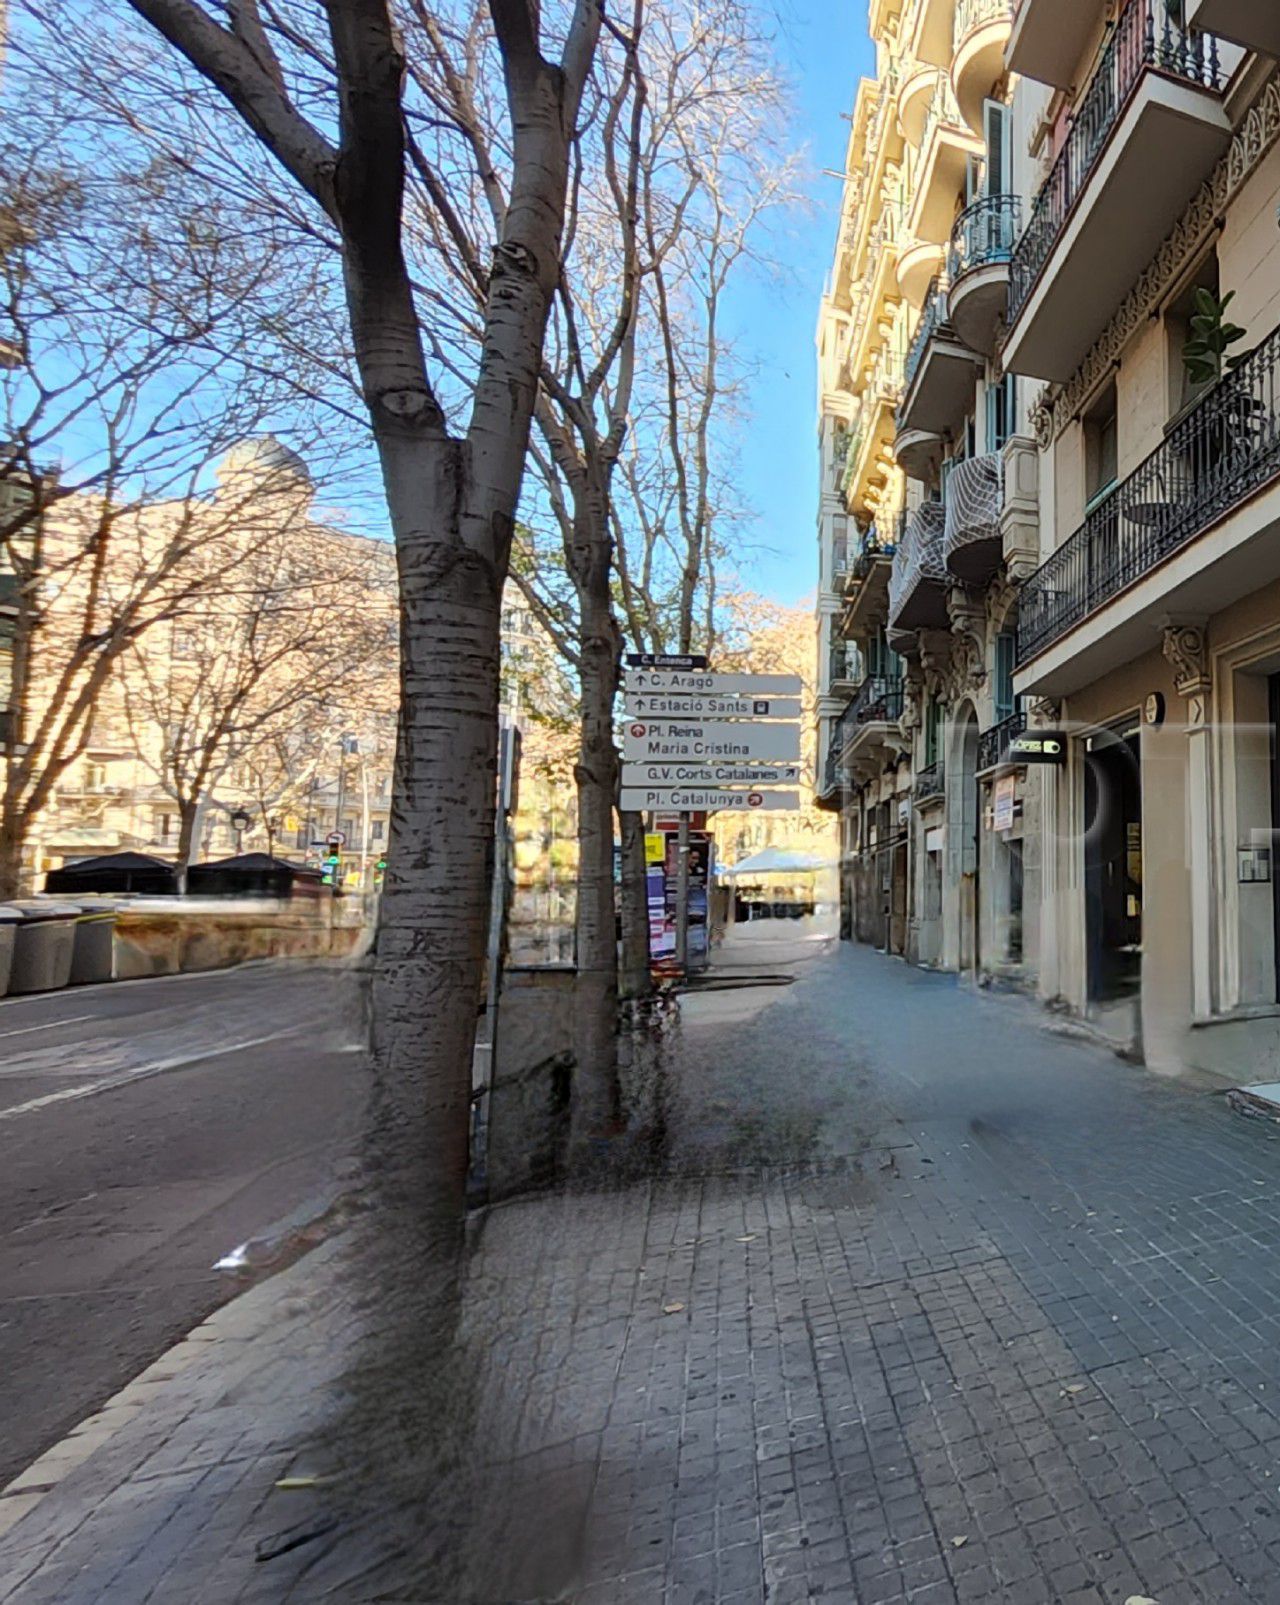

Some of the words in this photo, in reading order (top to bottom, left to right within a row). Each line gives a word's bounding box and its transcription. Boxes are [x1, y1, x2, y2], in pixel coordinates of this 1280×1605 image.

[650, 674, 665, 686] C.
[671, 674, 713, 690] Aragó
[649, 699, 703, 712] Estació
[708, 700, 748, 712] Sants
[648, 725, 664, 737] Pl.
[668, 725, 703, 738] Reina
[648, 742, 689, 754] Maria
[694, 742, 750, 755] Cristina
[648, 768, 673, 780] G.V.
[676, 768, 713, 780] Corts
[715, 768, 778, 780] Catalanes
[647, 792, 665, 804] Pl.
[670, 792, 743, 806] Catalunya
